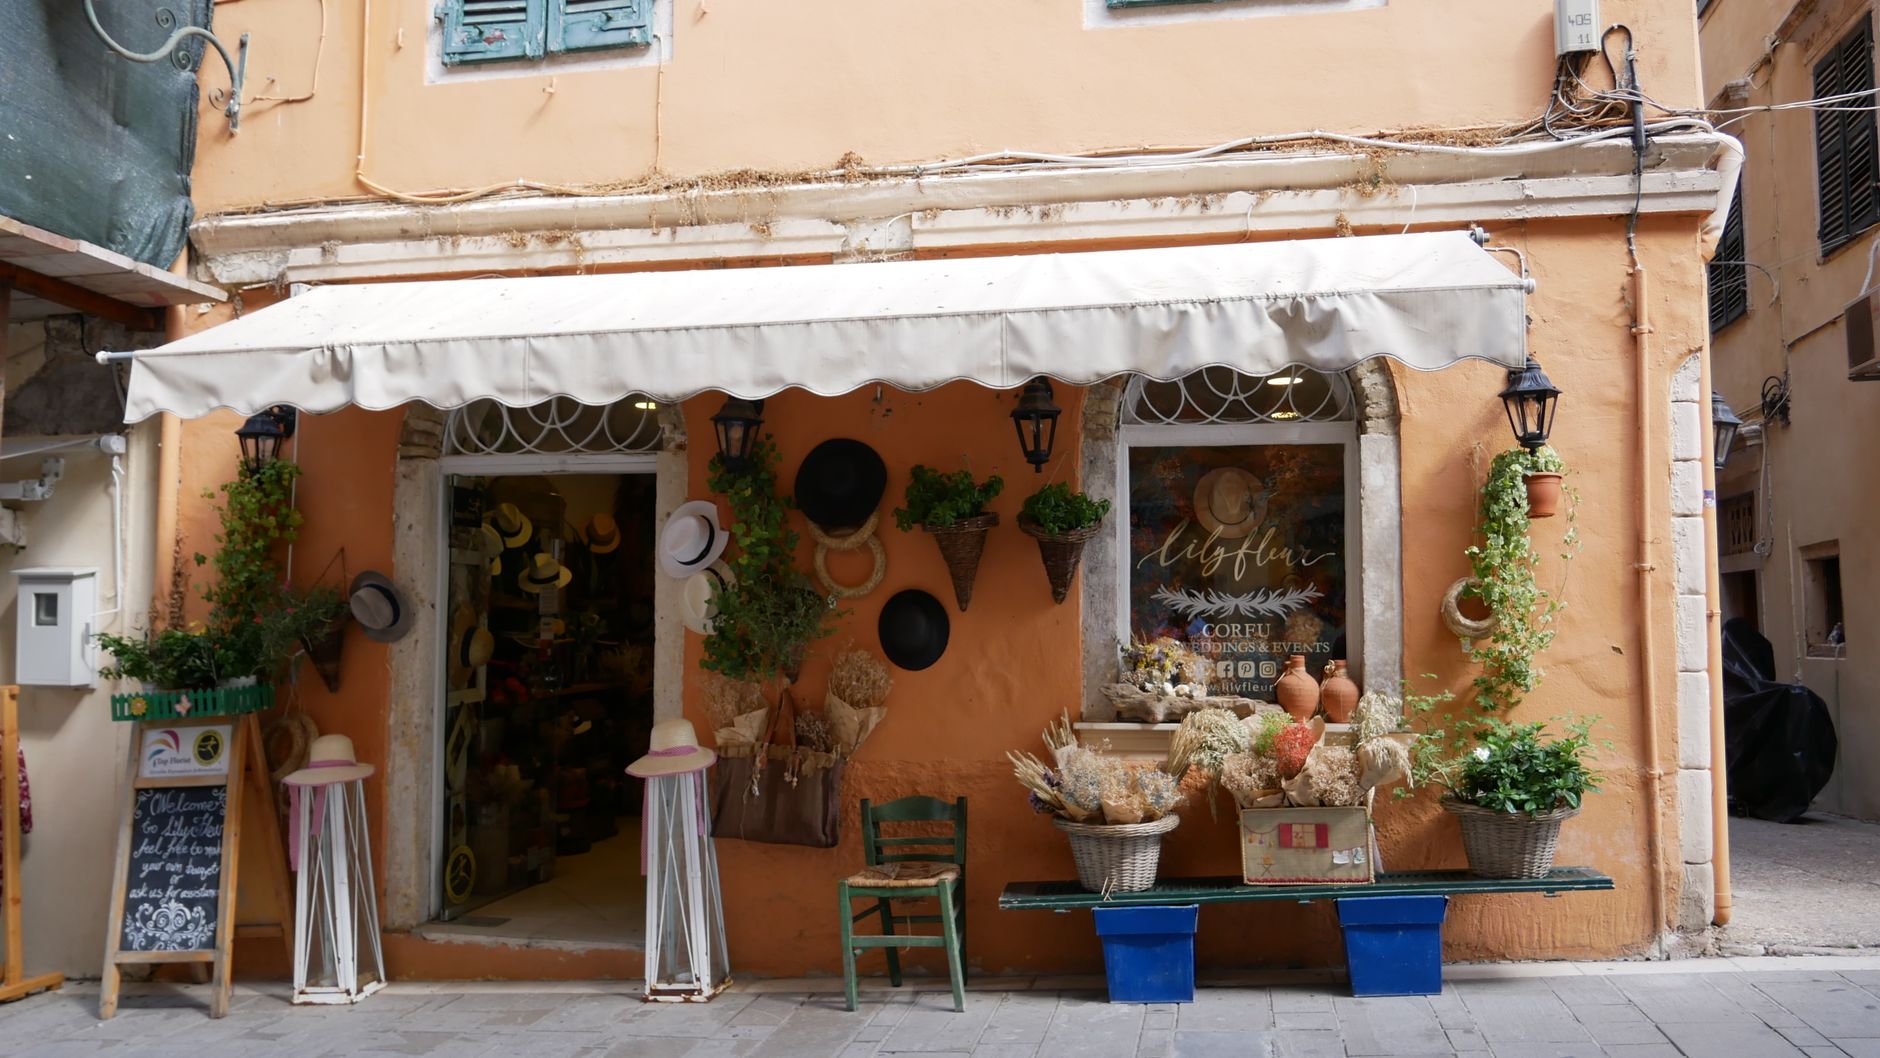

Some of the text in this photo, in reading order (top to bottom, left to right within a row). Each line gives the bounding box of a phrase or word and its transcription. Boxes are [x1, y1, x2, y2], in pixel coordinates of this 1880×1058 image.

[1137, 520, 1335, 581] lilyfleur
[1202, 623, 1271, 638] CORFU
[1258, 642, 1269, 653] &
[1272, 641, 1331, 653] EVENTS
[150, 790, 217, 816] Welcome
[133, 836, 163, 858] feel
[162, 836, 189, 859] free
[129, 882, 148, 898] ask
[149, 889, 163, 898] us
